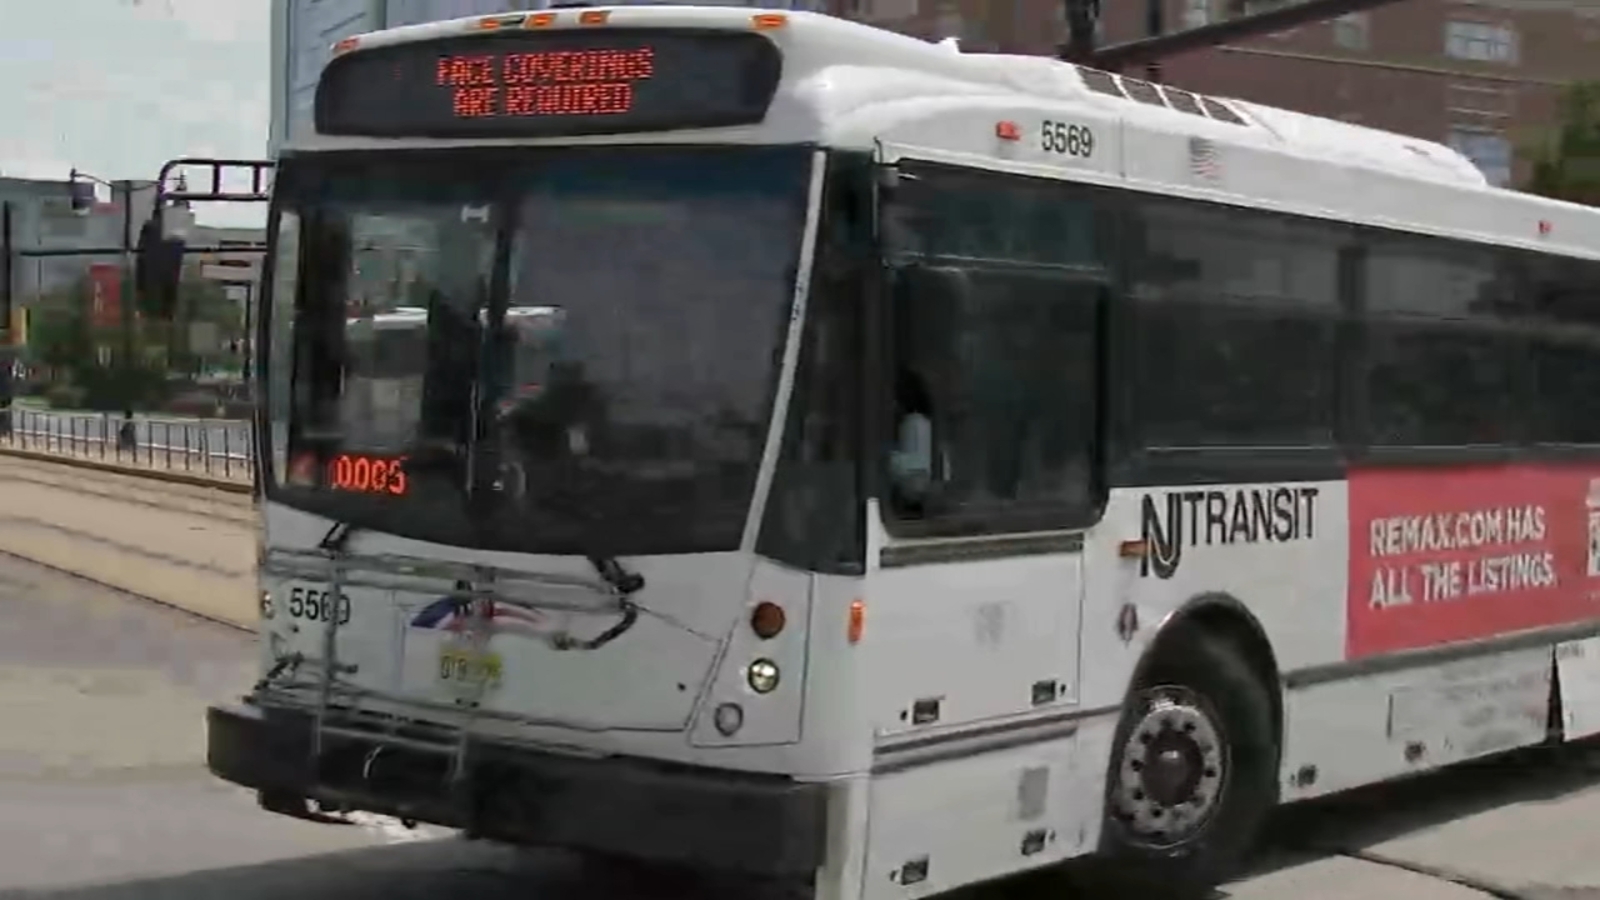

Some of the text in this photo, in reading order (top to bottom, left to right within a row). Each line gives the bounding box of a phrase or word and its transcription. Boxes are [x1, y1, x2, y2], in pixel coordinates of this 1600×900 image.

[503, 49, 654, 85] COVERINGS
[453, 83, 632, 116] ARE REQUIRED
[1042, 120, 1092, 157] 5569
[1370, 509, 1502, 557] REMAX.COM
[1507, 505, 1546, 543] HAS
[1369, 566, 1412, 609] ALL
[1421, 561, 1461, 601] THE
